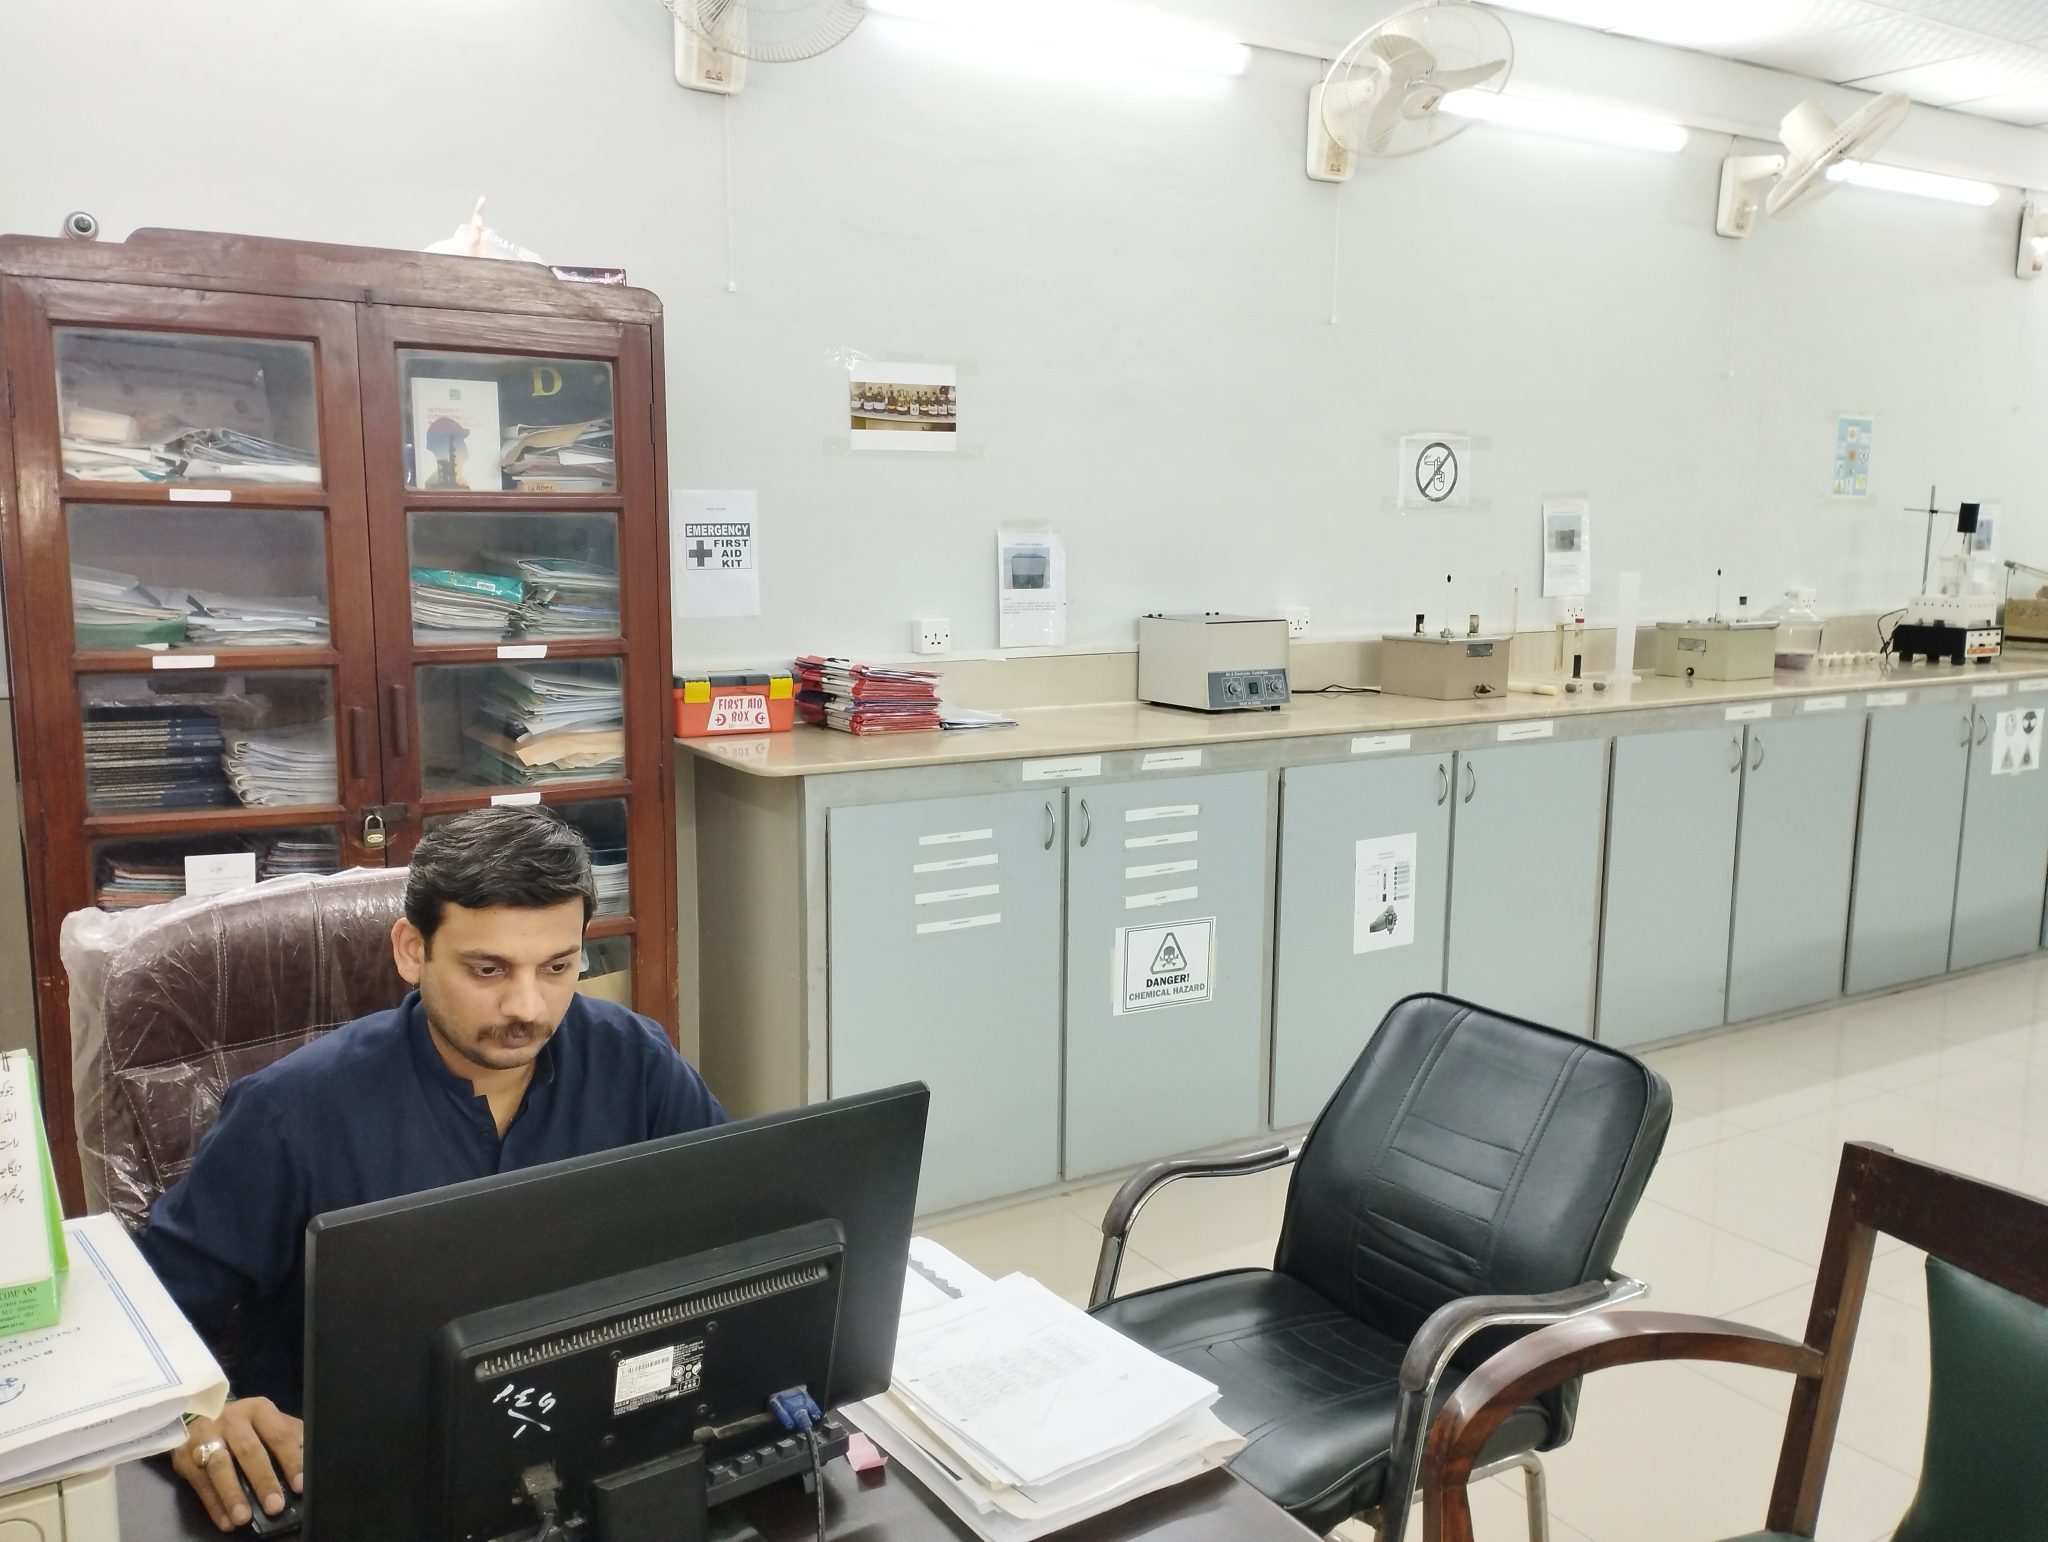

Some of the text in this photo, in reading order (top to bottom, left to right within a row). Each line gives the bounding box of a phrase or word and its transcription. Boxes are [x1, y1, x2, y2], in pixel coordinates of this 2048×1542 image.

[531, 366, 563, 397] D
[686, 524, 748, 537] EMERGENCY
[714, 539, 749, 548] FIRST
[721, 549, 742, 558] AID
[722, 559, 742, 568] KIT
[718, 697, 763, 710] FIRST AID
[731, 710, 750, 722] BOX
[1146, 973, 1190, 988] DANGER!
[1129, 983, 1205, 1001] CHEMICAL HAZARD
